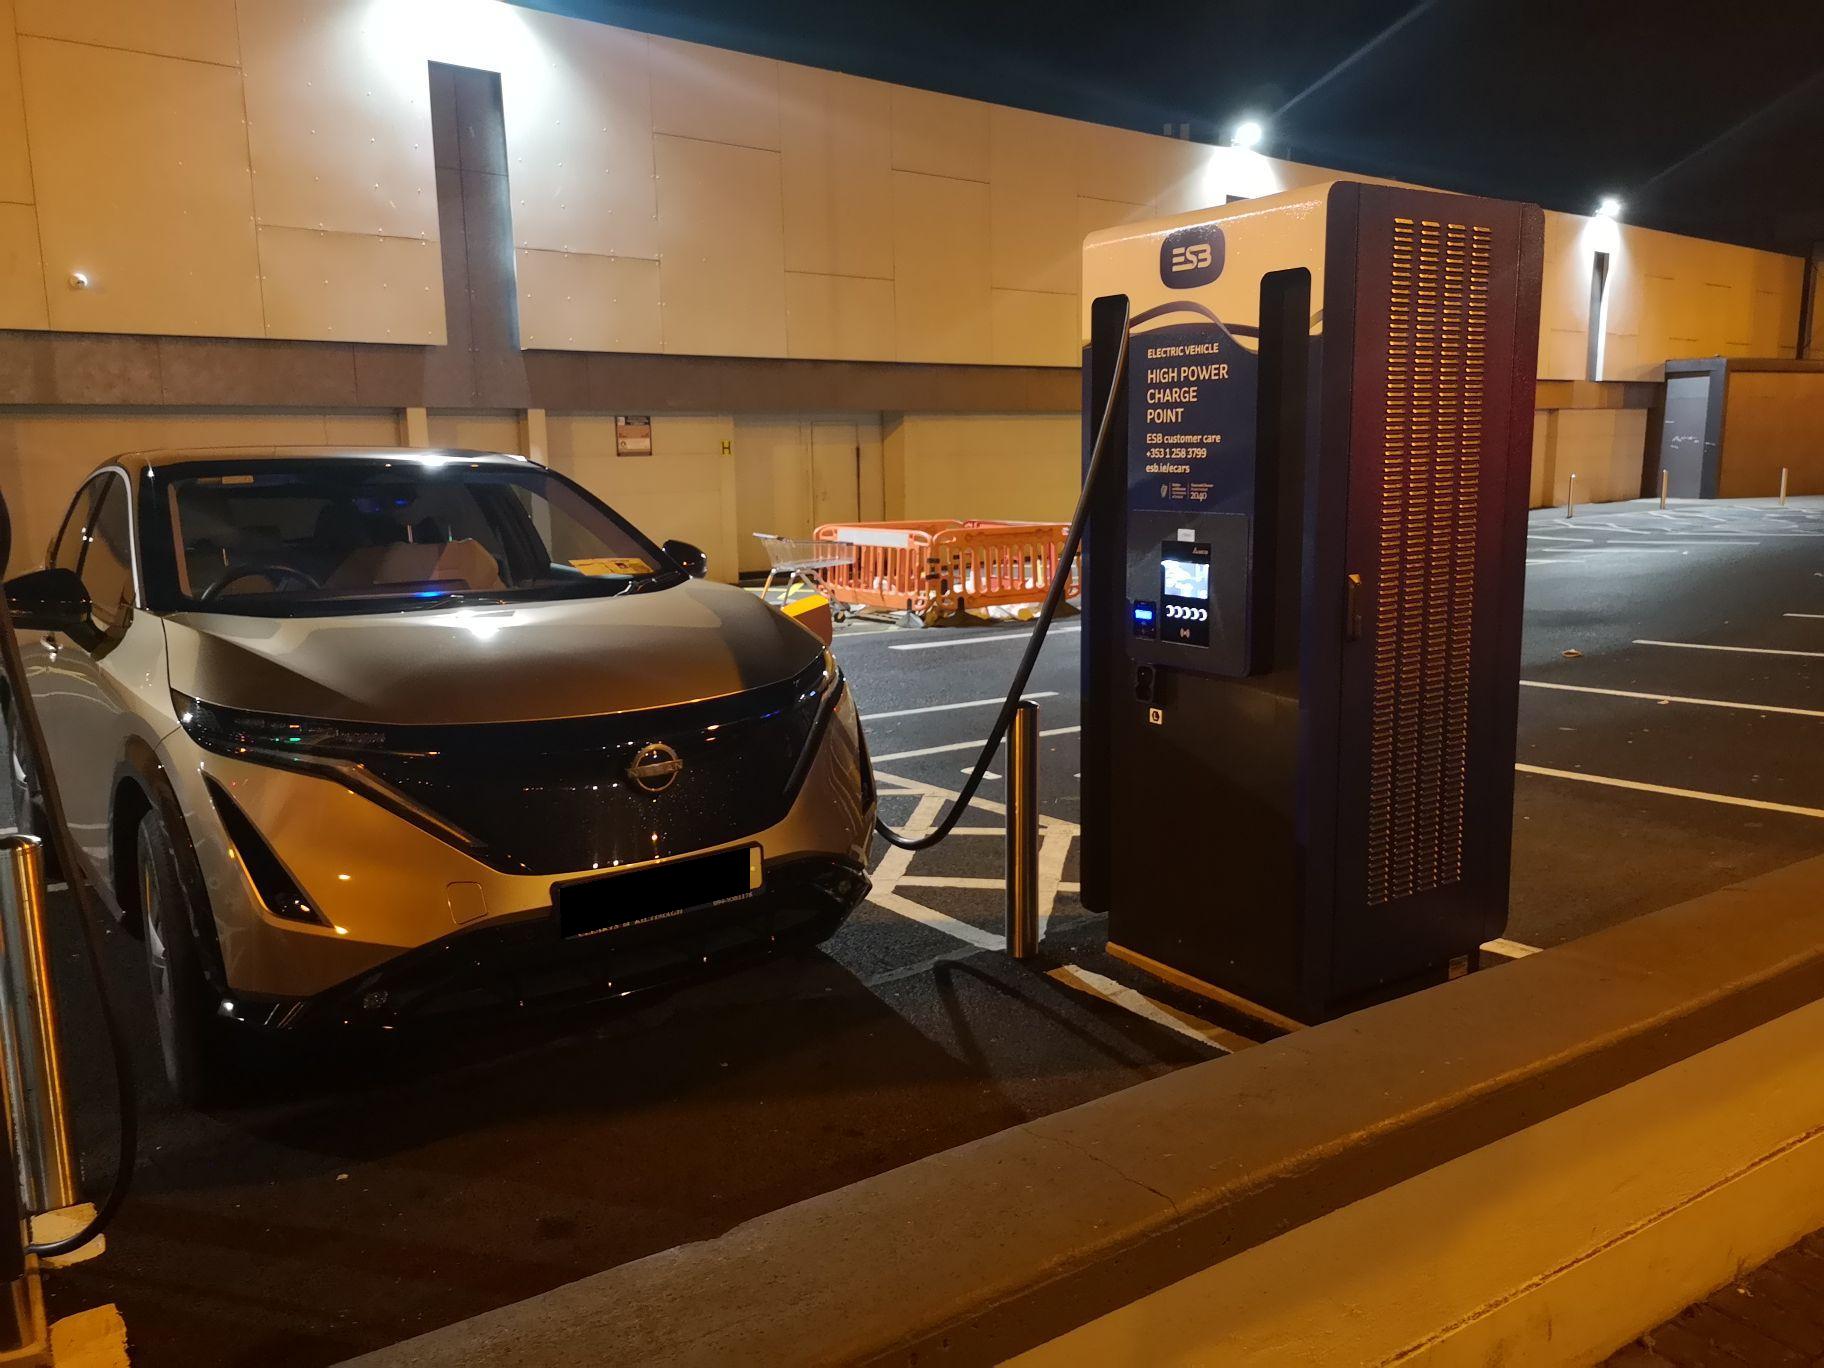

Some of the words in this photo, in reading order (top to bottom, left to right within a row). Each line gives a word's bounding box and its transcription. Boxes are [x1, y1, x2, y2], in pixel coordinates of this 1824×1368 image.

[1172, 243, 1212, 272] ESB
[1147, 345, 1184, 359] ELECTRIC
[1184, 342, 1220, 355] VEHICLE
[1147, 367, 1178, 384] HIGH
[1180, 363, 1229, 382] POWER
[1146, 386, 1198, 404] CHARGE
[1146, 408, 1185, 424] POINT
[1146, 432, 1163, 444] ESB
[1163, 434, 1202, 444] customer
[1202, 434, 1222, 444] care
[721, 440, 732, 456] H
[1146, 448, 1165, 458] +353
[1165, 448, 1170, 458] 1
[1171, 448, 1186, 458] 258
[1187, 447, 1207, 458] 3799
[1145, 462, 1191, 474] esb.ie/ecars
